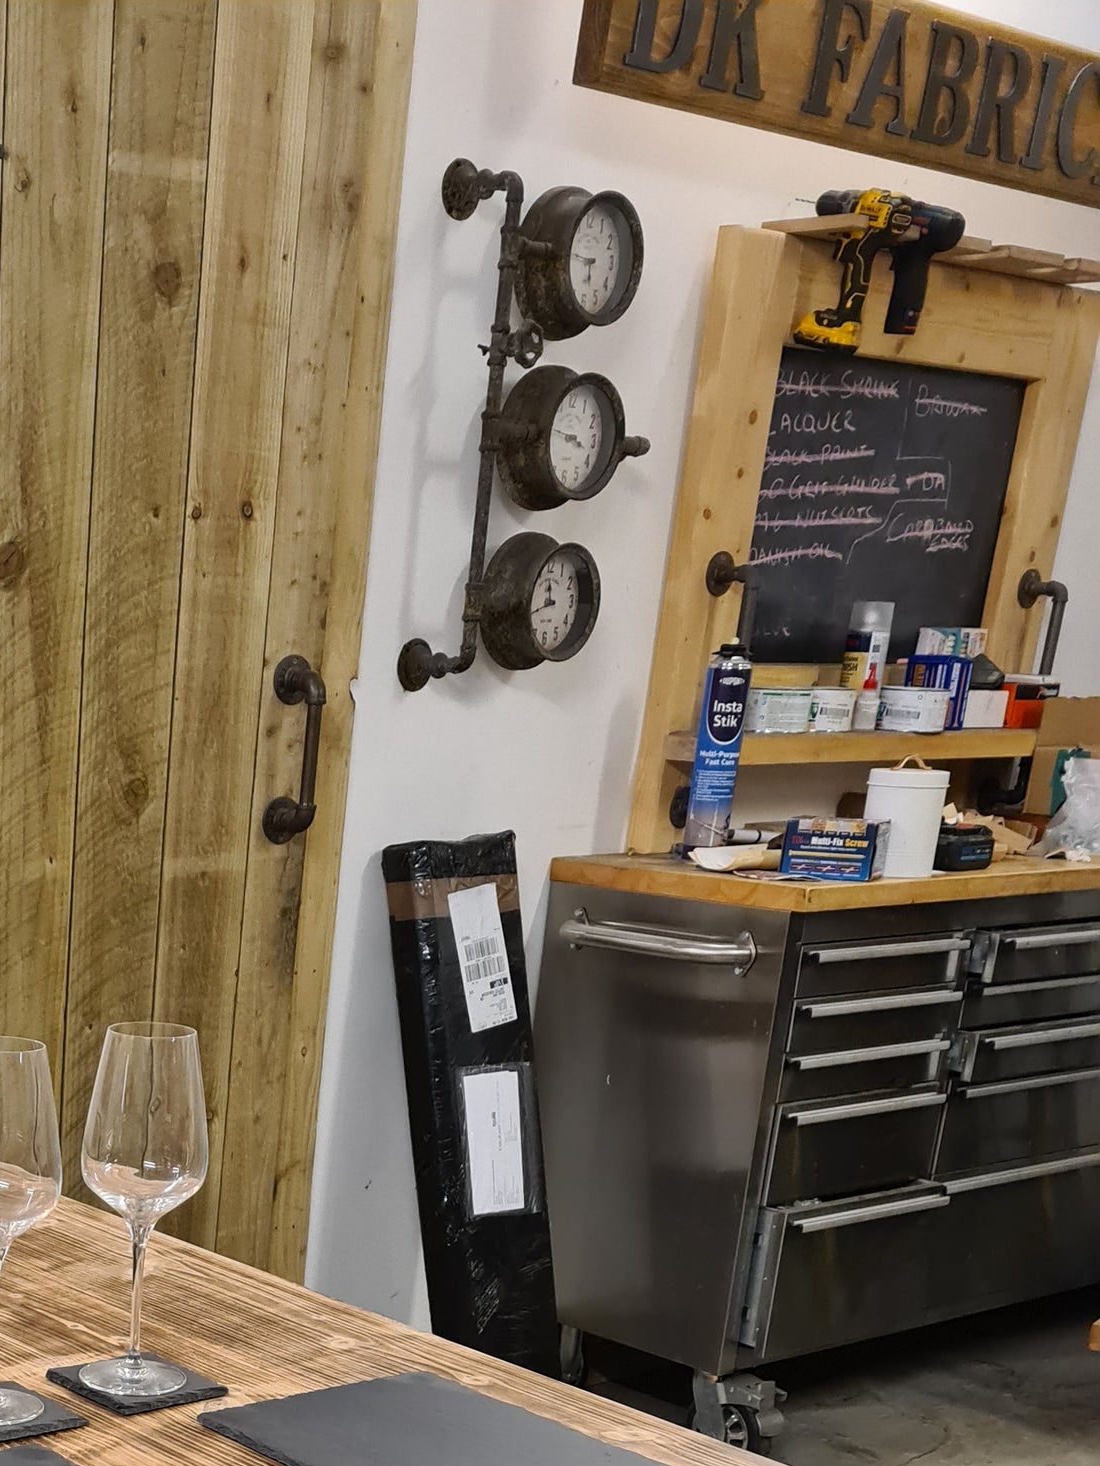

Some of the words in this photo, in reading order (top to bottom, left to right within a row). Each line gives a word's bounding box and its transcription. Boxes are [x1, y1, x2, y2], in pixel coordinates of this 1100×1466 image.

[624, 0, 764, 100] DK
[800, 0, 1100, 185] FABRIC
[606, 233, 613, 250] 2
[608, 254, 614, 271] 3
[603, 276, 609, 292] 4
[592, 289, 599, 306] 5
[589, 413, 597, 430] 2
[768, 409, 857, 436] ACQUER
[591, 433, 597, 450] 3
[584, 453, 591, 469] 4
[573, 466, 580, 482] 5
[567, 576, 574, 591] 2
[568, 594, 574, 609] 3
[563, 613, 569, 627] 4
[541, 631, 548, 646] 6
[553, 627, 559, 642] 5
[713, 700, 743, 713] Insta
[713, 714, 738, 728] Stik
[811, 836, 843, 846] Multi-Fix
[845, 839, 870, 848] Screw
